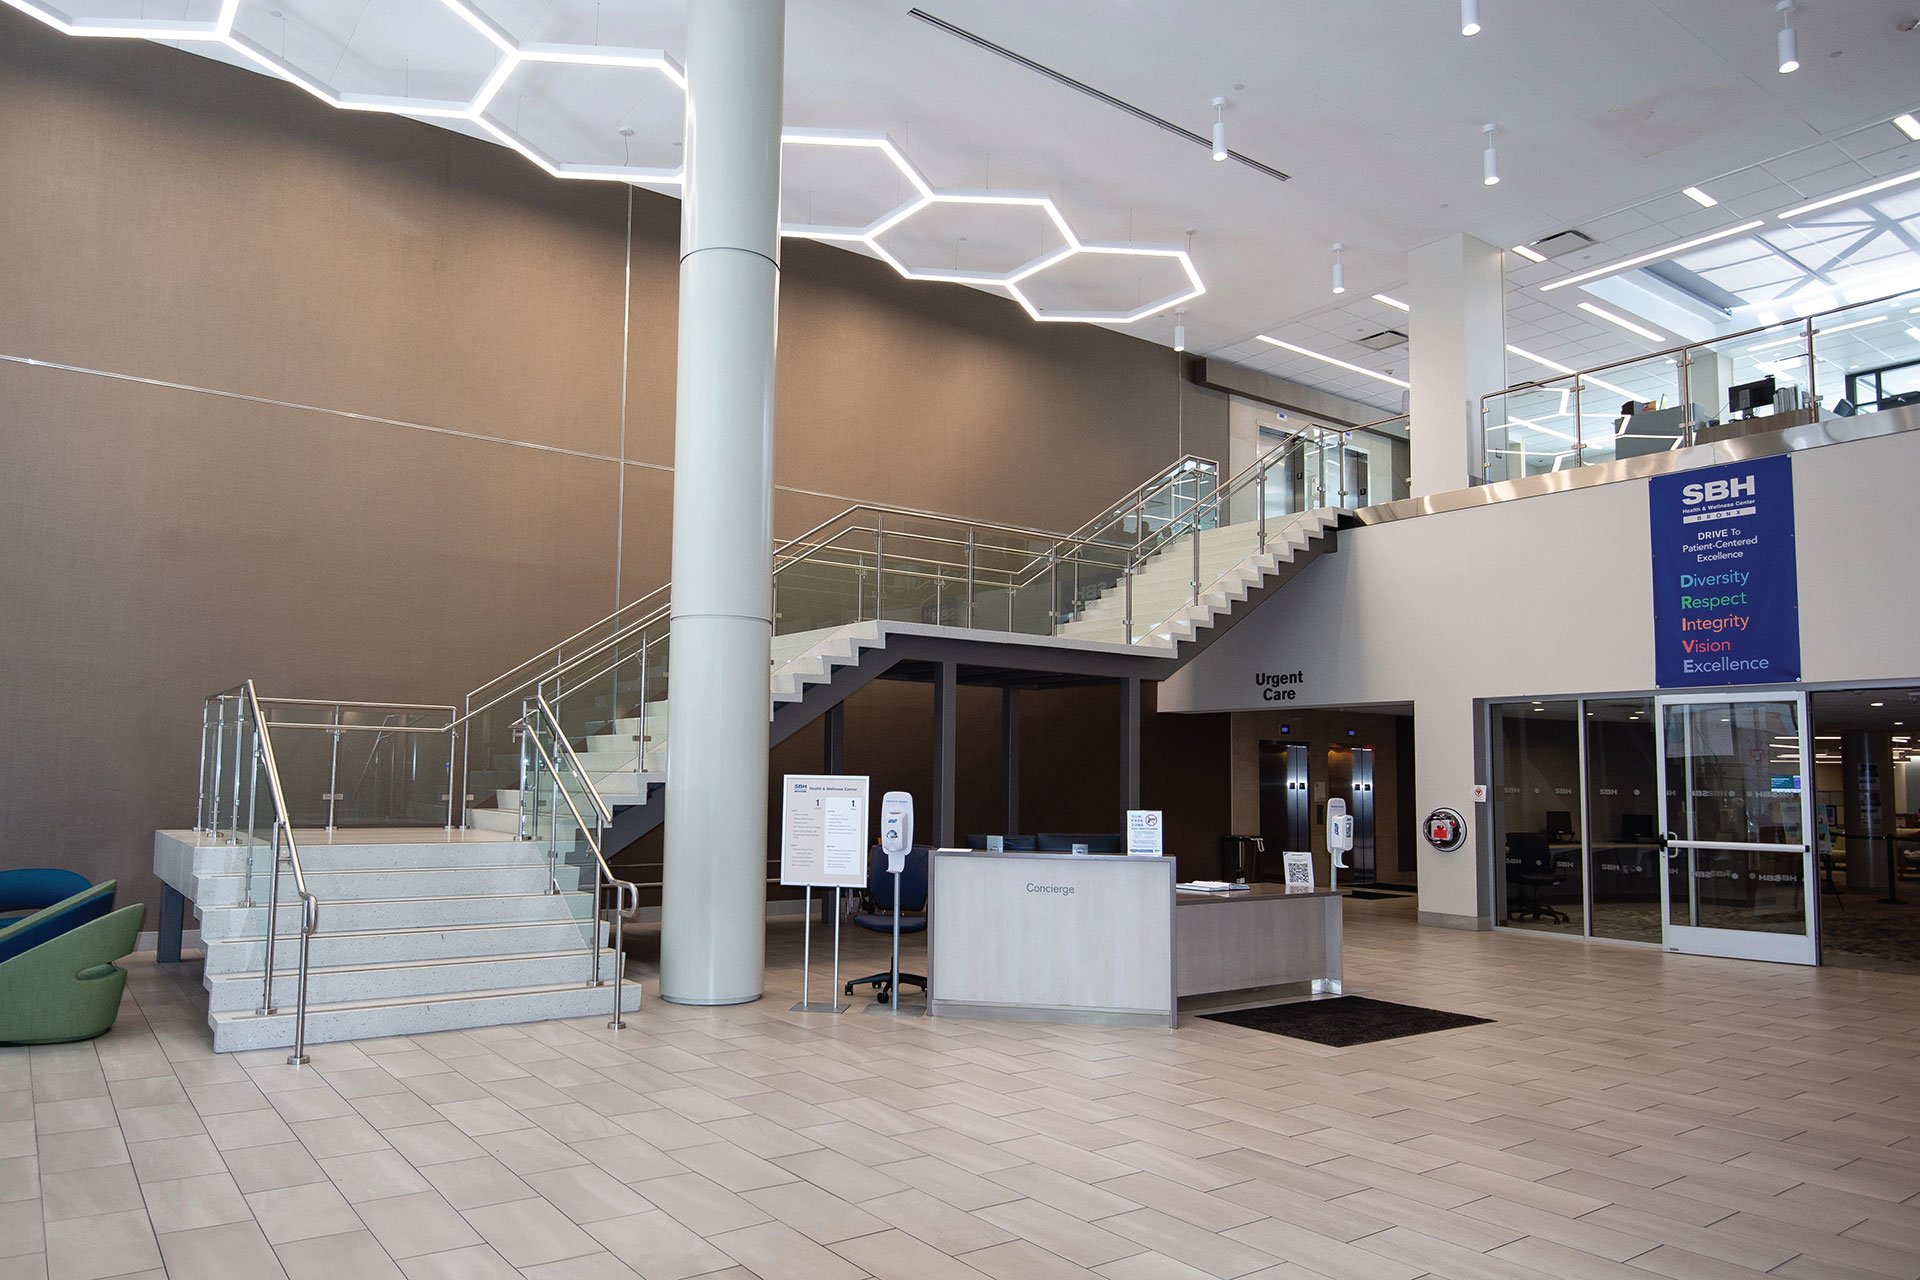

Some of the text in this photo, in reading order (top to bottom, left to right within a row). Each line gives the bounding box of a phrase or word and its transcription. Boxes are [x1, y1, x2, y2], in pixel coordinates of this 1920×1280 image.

[1682, 475, 1755, 505] SBH
[1708, 502, 1734, 510] Wellness
[1735, 499, 1755, 507] Center
[1698, 528, 1741, 540] DRIVE To
[1682, 535, 1758, 553] Patient-Centered
[1697, 551, 1744, 562] Excellence
[1680, 569, 1749, 588] Diversity
[1681, 592, 1747, 610] Respect
[1681, 614, 1749, 633] Integrity
[1682, 638, 1731, 654] Vision
[1683, 656, 1769, 673] Excellence
[1255, 670, 1304, 687] Urgent
[1263, 688, 1296, 701] Care
[1026, 882, 1075, 896] Concierge
